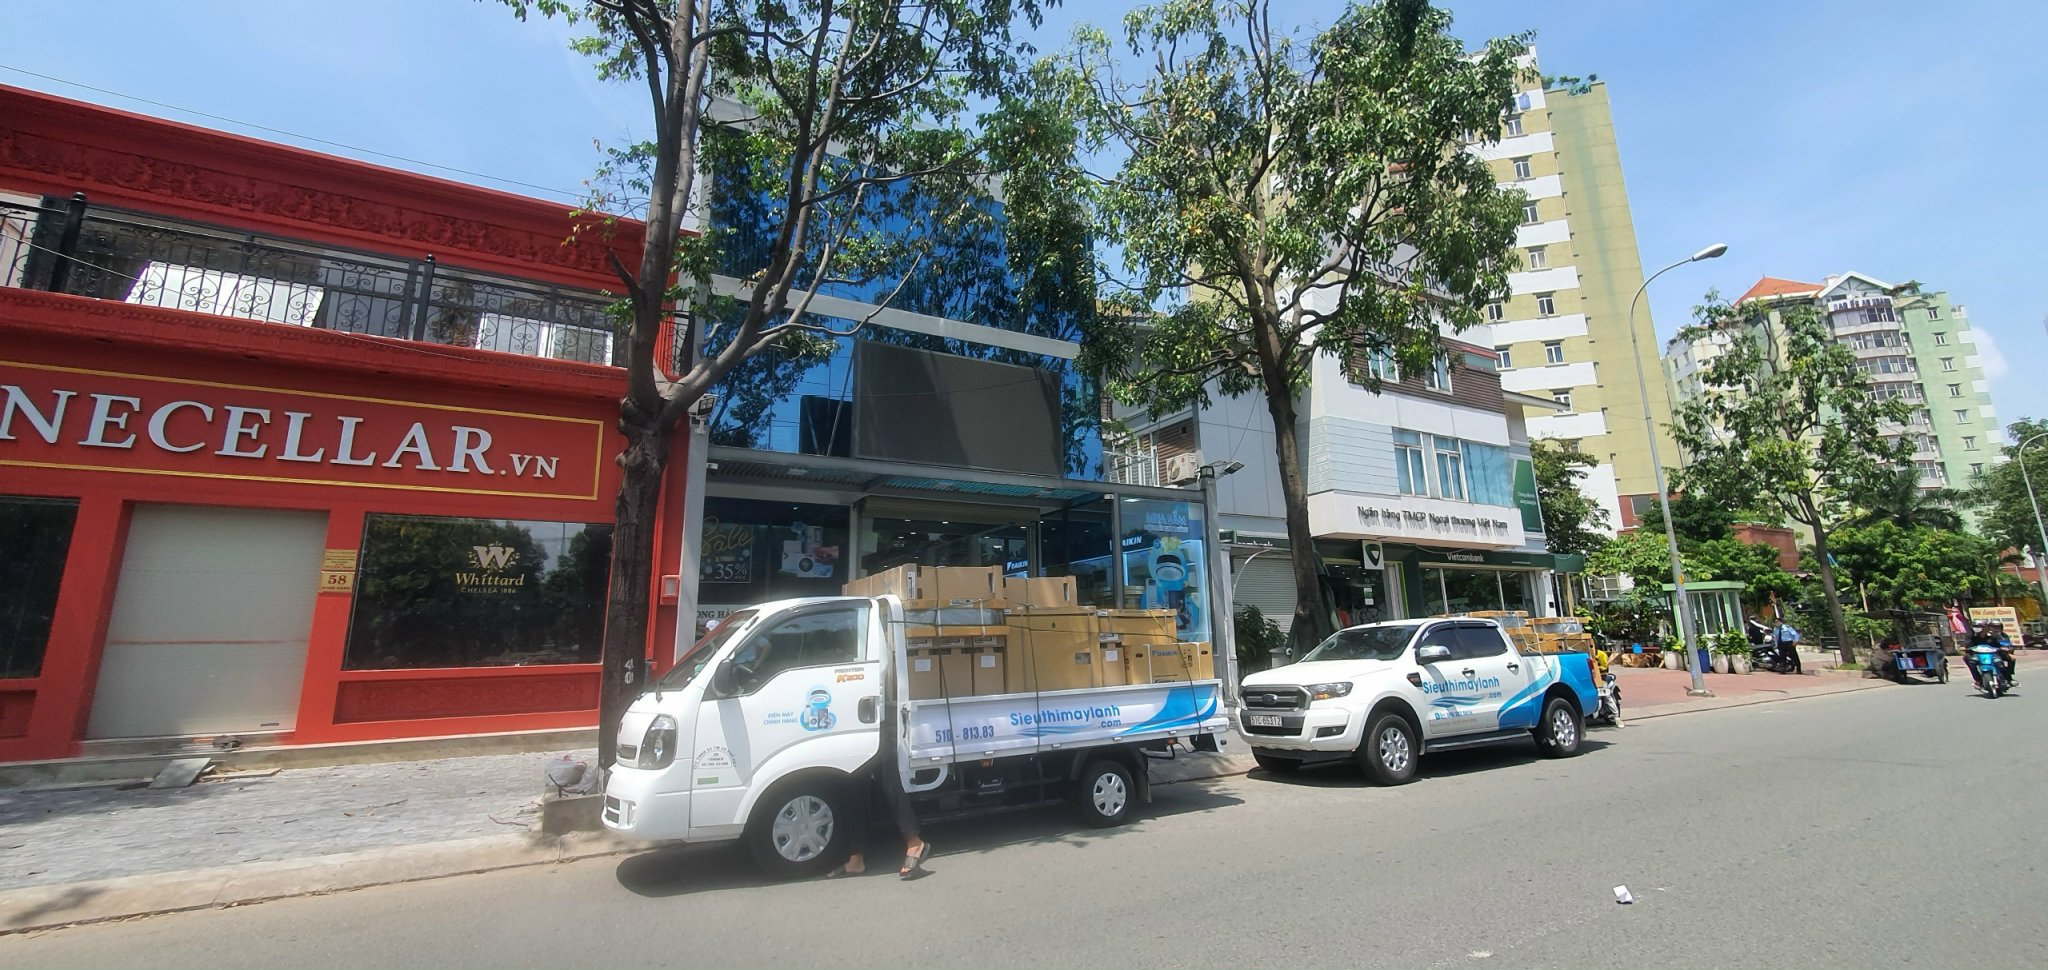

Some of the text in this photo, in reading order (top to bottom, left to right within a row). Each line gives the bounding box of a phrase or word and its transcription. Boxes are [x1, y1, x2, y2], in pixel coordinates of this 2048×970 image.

[1122, 535, 1142, 547] AIKIN
[1447, 552, 1484, 562] Vietcombank
[714, 563, 747, 579] 35%
[328, 574, 347, 585] 58
[455, 573, 525, 586] Whittard
[1423, 677, 1500, 694] Sieuthimaylanh
[1010, 704, 1121, 727] Sieuthimaylanh
[1098, 719, 1122, 730] .com
[962, 725, 995, 740] 813.83
